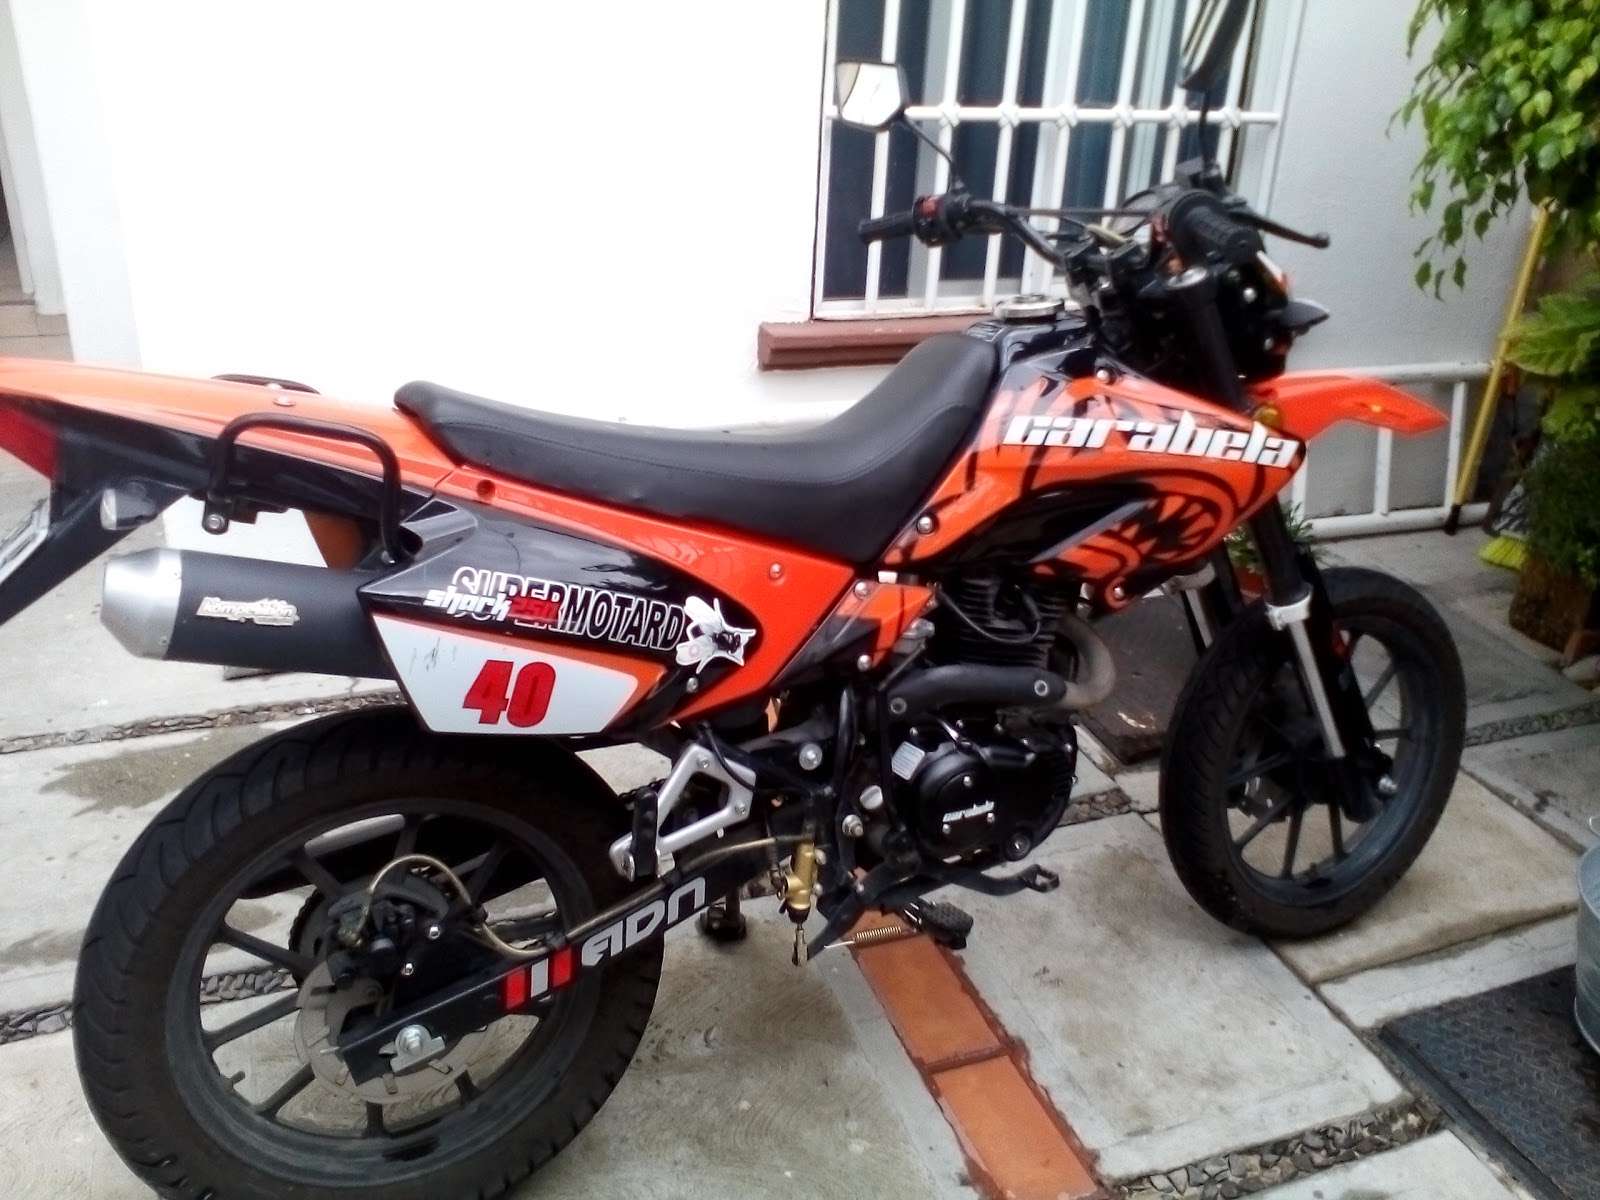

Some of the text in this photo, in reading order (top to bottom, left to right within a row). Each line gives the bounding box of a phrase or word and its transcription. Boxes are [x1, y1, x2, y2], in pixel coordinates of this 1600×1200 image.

[1003, 410, 1300, 468] carabela
[423, 585, 512, 622] shark
[463, 660, 557, 728] 40
